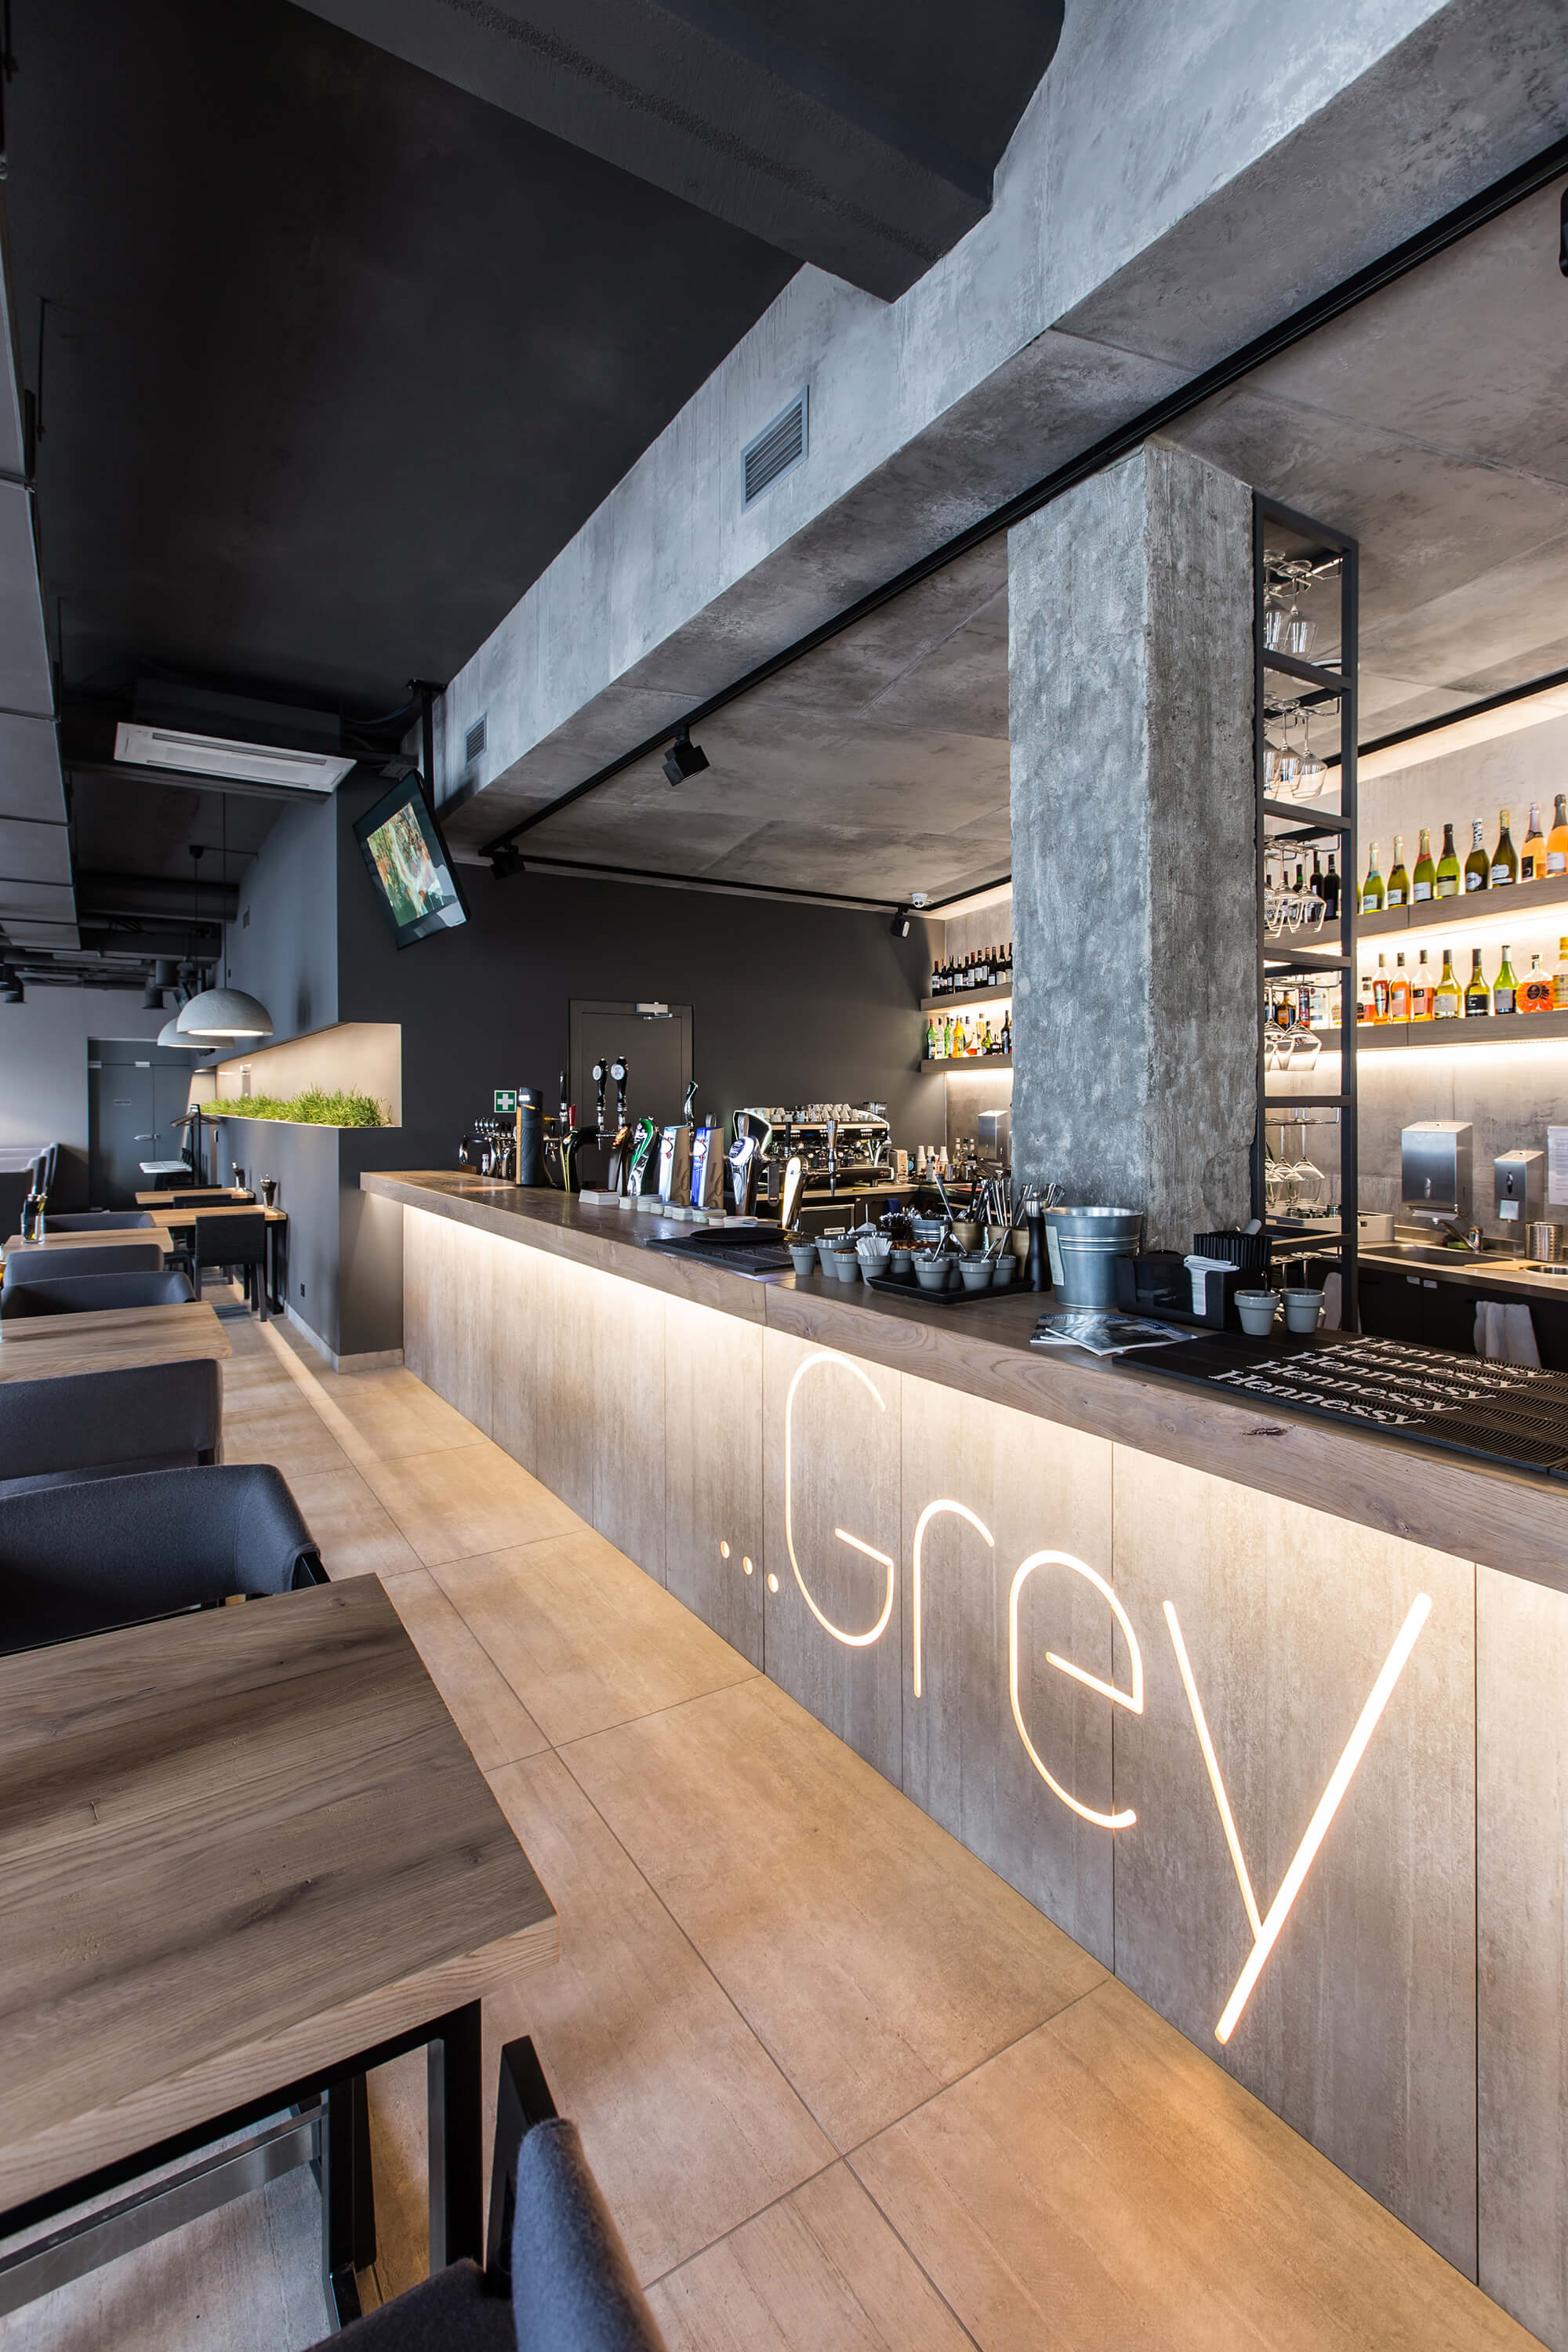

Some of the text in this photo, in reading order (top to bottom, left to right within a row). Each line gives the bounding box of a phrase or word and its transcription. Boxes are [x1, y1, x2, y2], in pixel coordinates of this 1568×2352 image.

[1282, 1351, 1497, 1400] Hennessy
[1315, 1344, 1527, 1389] Hennessy
[1348, 1336, 1554, 1379] Hennessy
[1207, 1369, 1426, 1425] Hennessy
[1247, 1360, 1462, 1412] Hennessy
